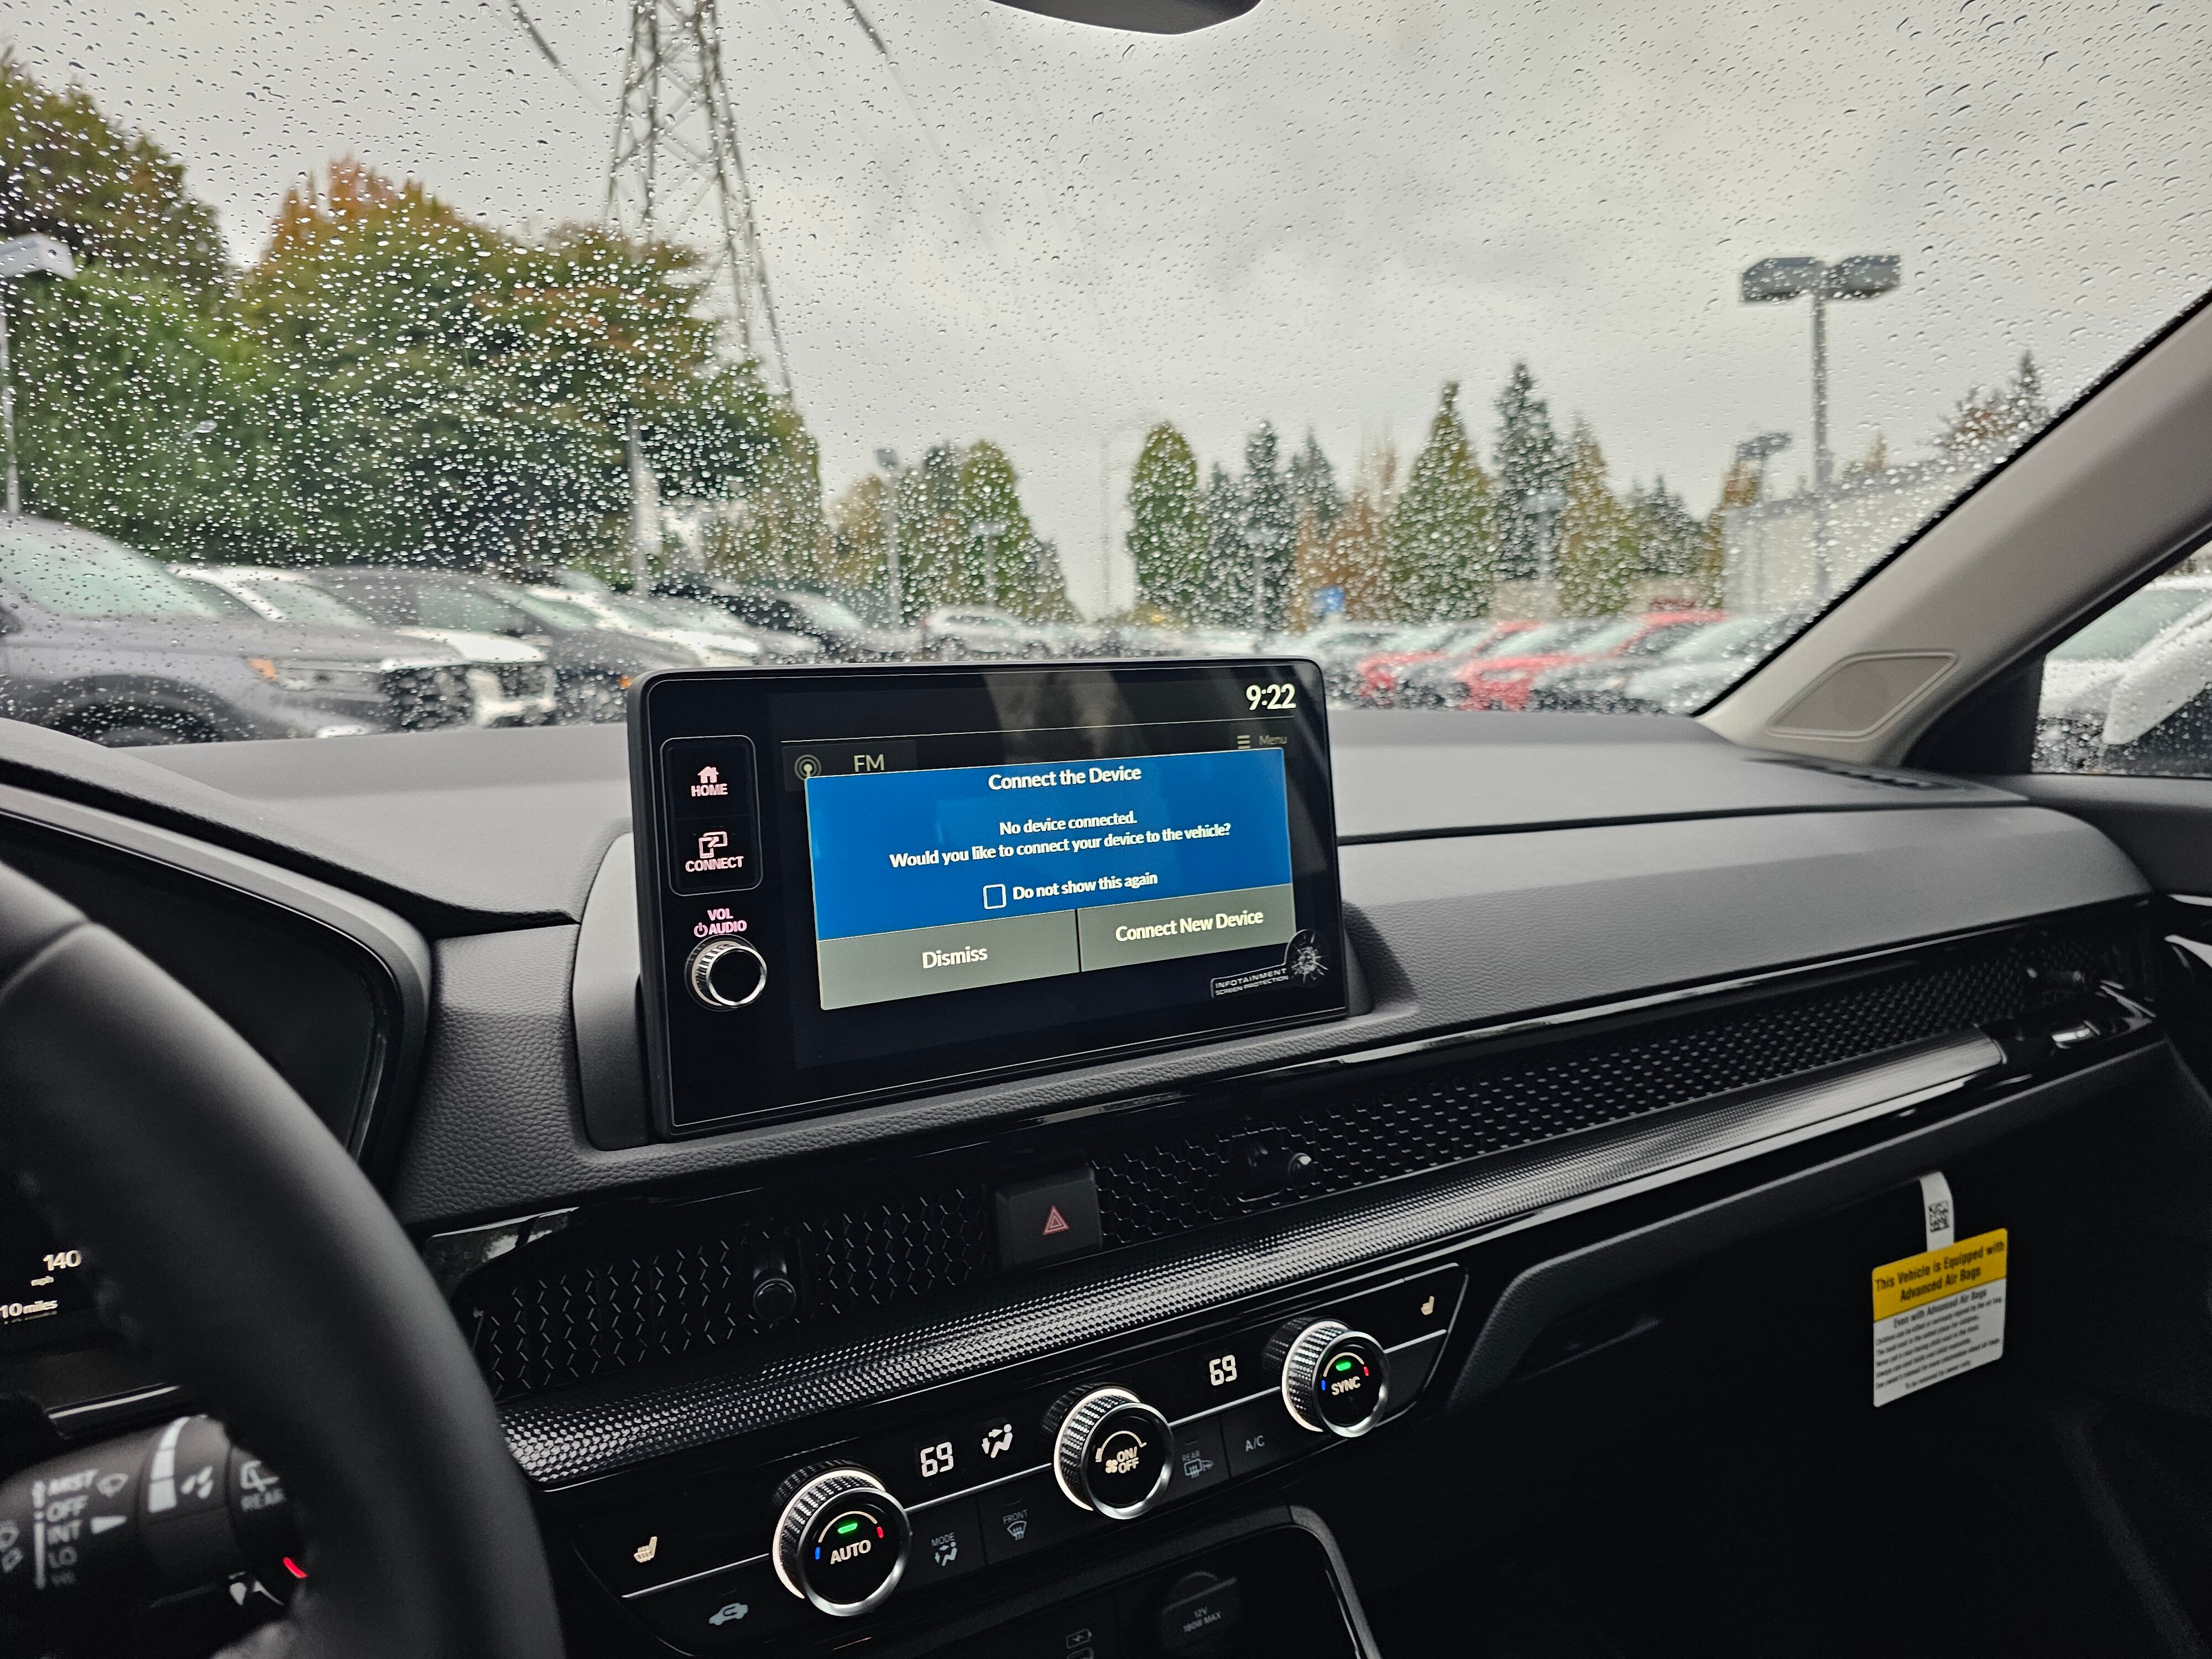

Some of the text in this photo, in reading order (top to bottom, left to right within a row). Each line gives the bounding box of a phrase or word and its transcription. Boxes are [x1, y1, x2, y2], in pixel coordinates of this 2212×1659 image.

[1246, 684, 1296, 711] 9:22
[1259, 735, 1287, 745] Menu
[853, 754, 884, 772] FM
[988, 765, 1141, 790] Connect the Device
[691, 783, 728, 796] HOME
[999, 811, 1138, 835] No device connected.
[889, 823, 1231, 868] Would you like to connect your device to the vehicle?
[685, 856, 744, 872] CONNECT
[1013, 872, 1158, 900] Do not show this again
[707, 908, 734, 921] VOL
[708, 920, 747, 935] AUDIO
[1115, 910, 1264, 942] Connect New Device
[922, 946, 988, 969] Dismiss
[1215, 968, 1287, 988] INFOTAINMENT
[1215, 975, 1289, 995] SCREEN PROTECTION
[43, 1250, 82, 1271] 140
[1874, 1241, 2004, 1292] This Vehicle is Equipped with
[1900, 1266, 1981, 1302] Advanced Air Bags
[1209, 1354, 1238, 1386] 69
[1331, 1376, 1361, 1395] SYNC
[1245, 1435, 1265, 1452] A/C
[920, 1442, 954, 1477] 69
[1117, 1446, 1138, 1463] ON/
[1182, 1451, 1200, 1462] REAR
[1118, 1457, 1139, 1473] OFF
[46, 1495, 88, 1522] OFF
[1003, 1509, 1028, 1524] FRONT
[931, 1532, 956, 1547] MODE
[830, 1540, 872, 1564] AUTO
